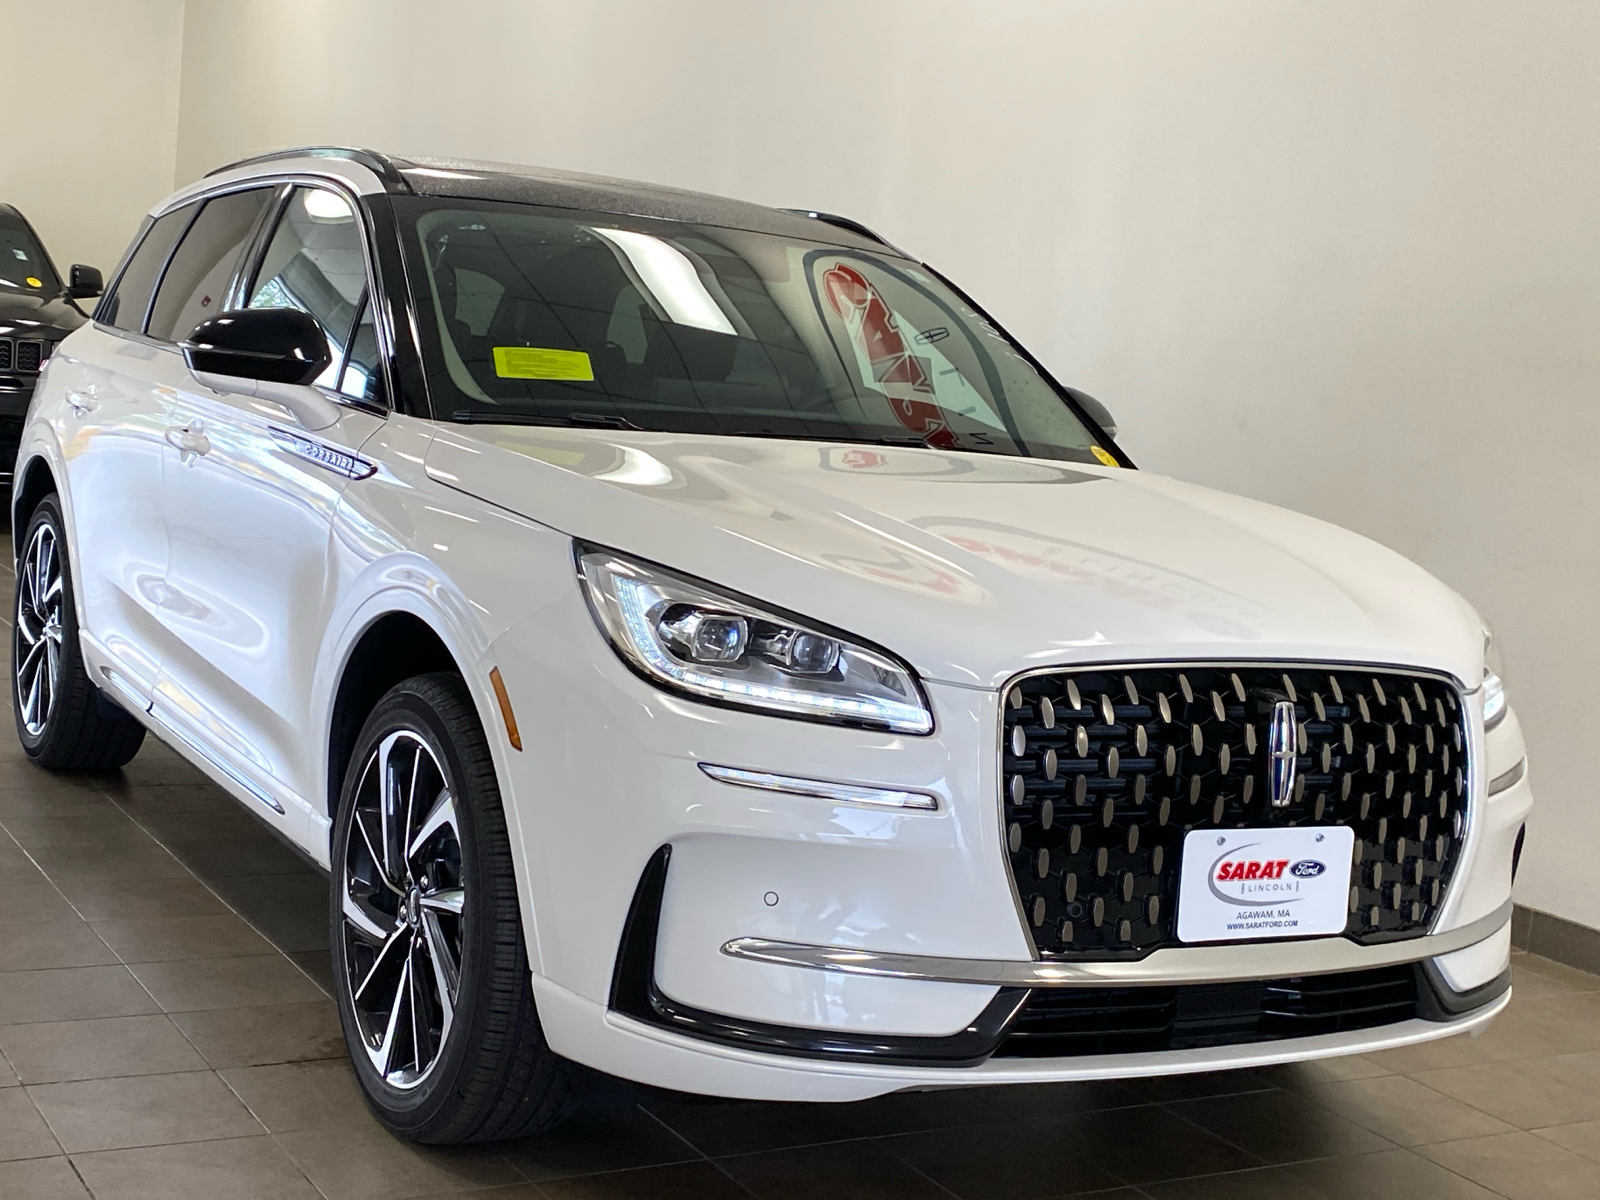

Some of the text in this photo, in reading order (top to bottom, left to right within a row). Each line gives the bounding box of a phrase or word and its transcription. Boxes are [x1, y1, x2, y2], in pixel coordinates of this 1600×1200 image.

[1217, 859, 1320, 881] SARAT Ford
[1248, 883, 1292, 892] LINCOLN
[1236, 910, 1290, 920] AGAWAM, MA
[1227, 920, 1298, 930] WWW.SARATFORD.COM
